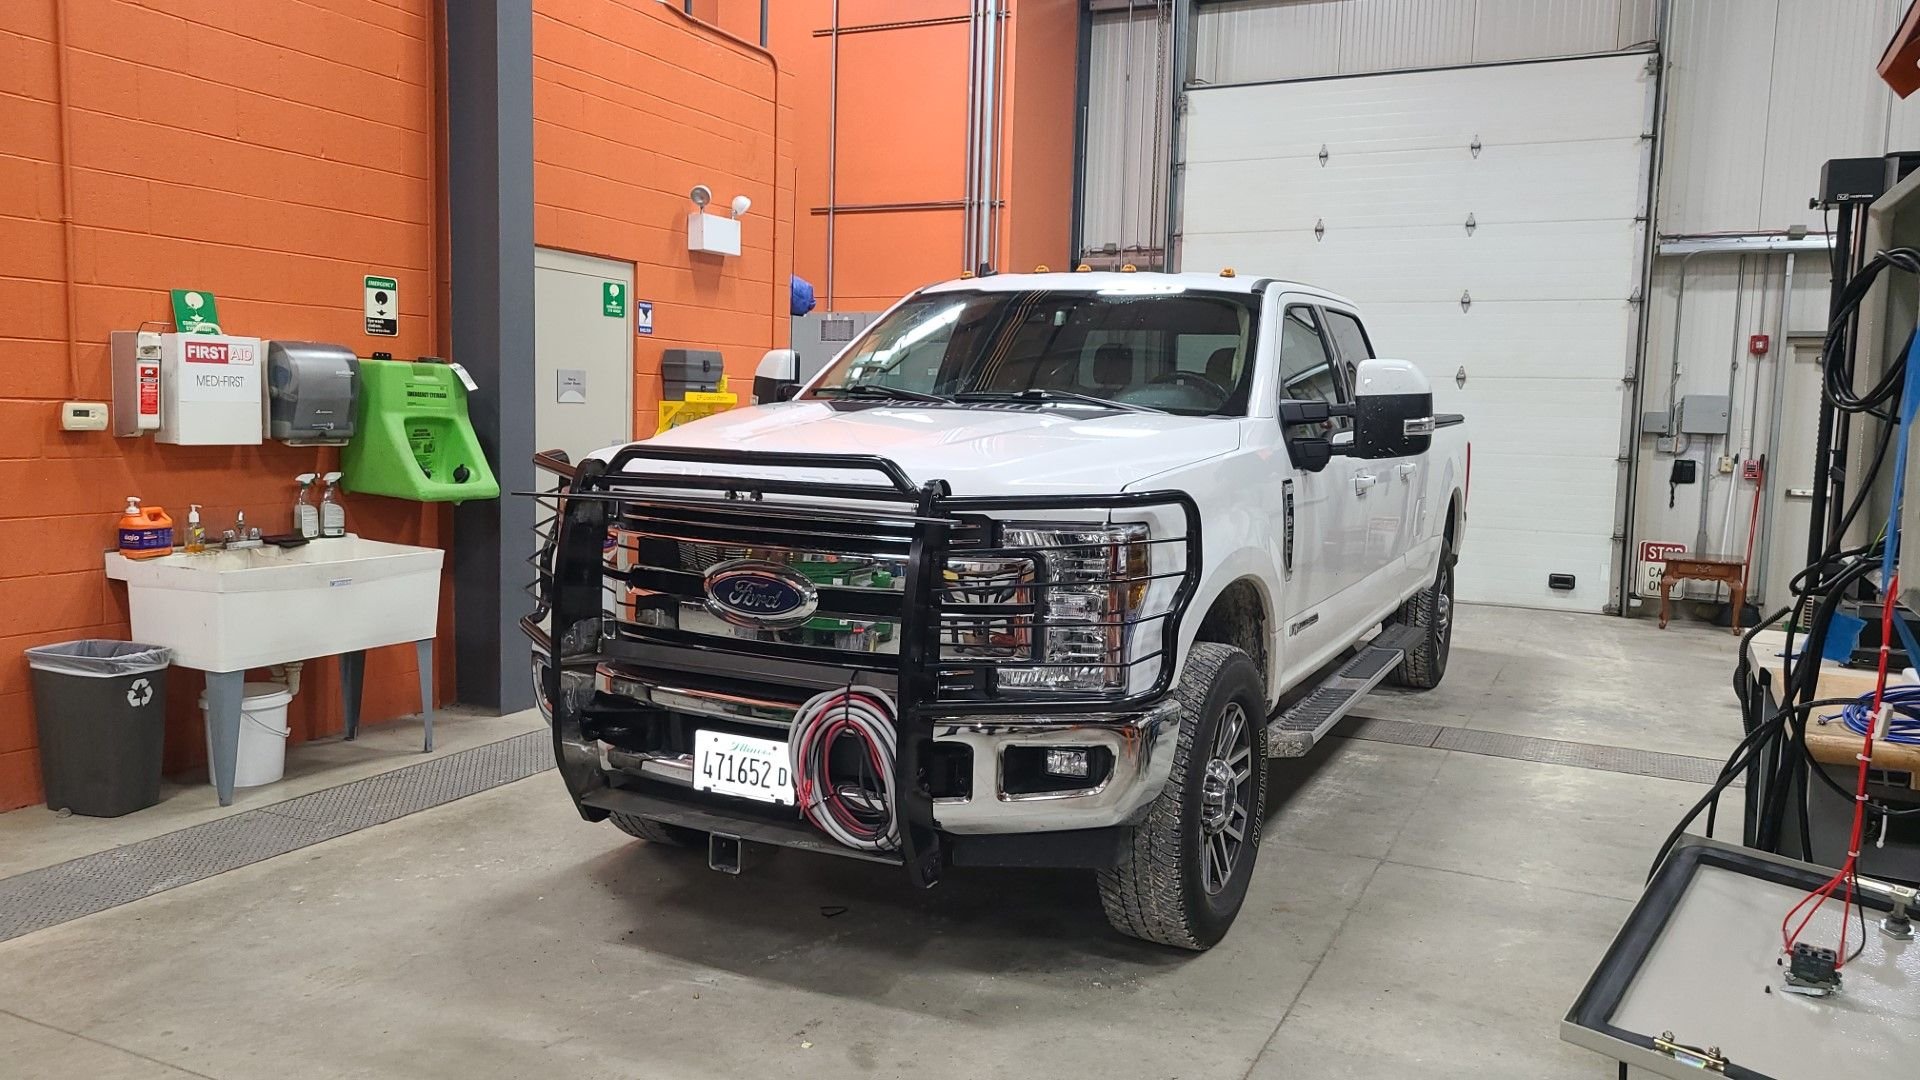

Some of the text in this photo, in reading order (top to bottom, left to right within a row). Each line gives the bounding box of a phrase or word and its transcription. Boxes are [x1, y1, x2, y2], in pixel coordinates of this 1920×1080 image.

[367, 280, 394, 288] EMERGENCY
[187, 345, 253, 361] FIRST AID
[196, 374, 244, 387] MEDI-FIRST
[728, 580, 783, 609] Ford
[703, 750, 787, 789] 471652 D
[1251, 727, 1267, 847] MICHELIN
